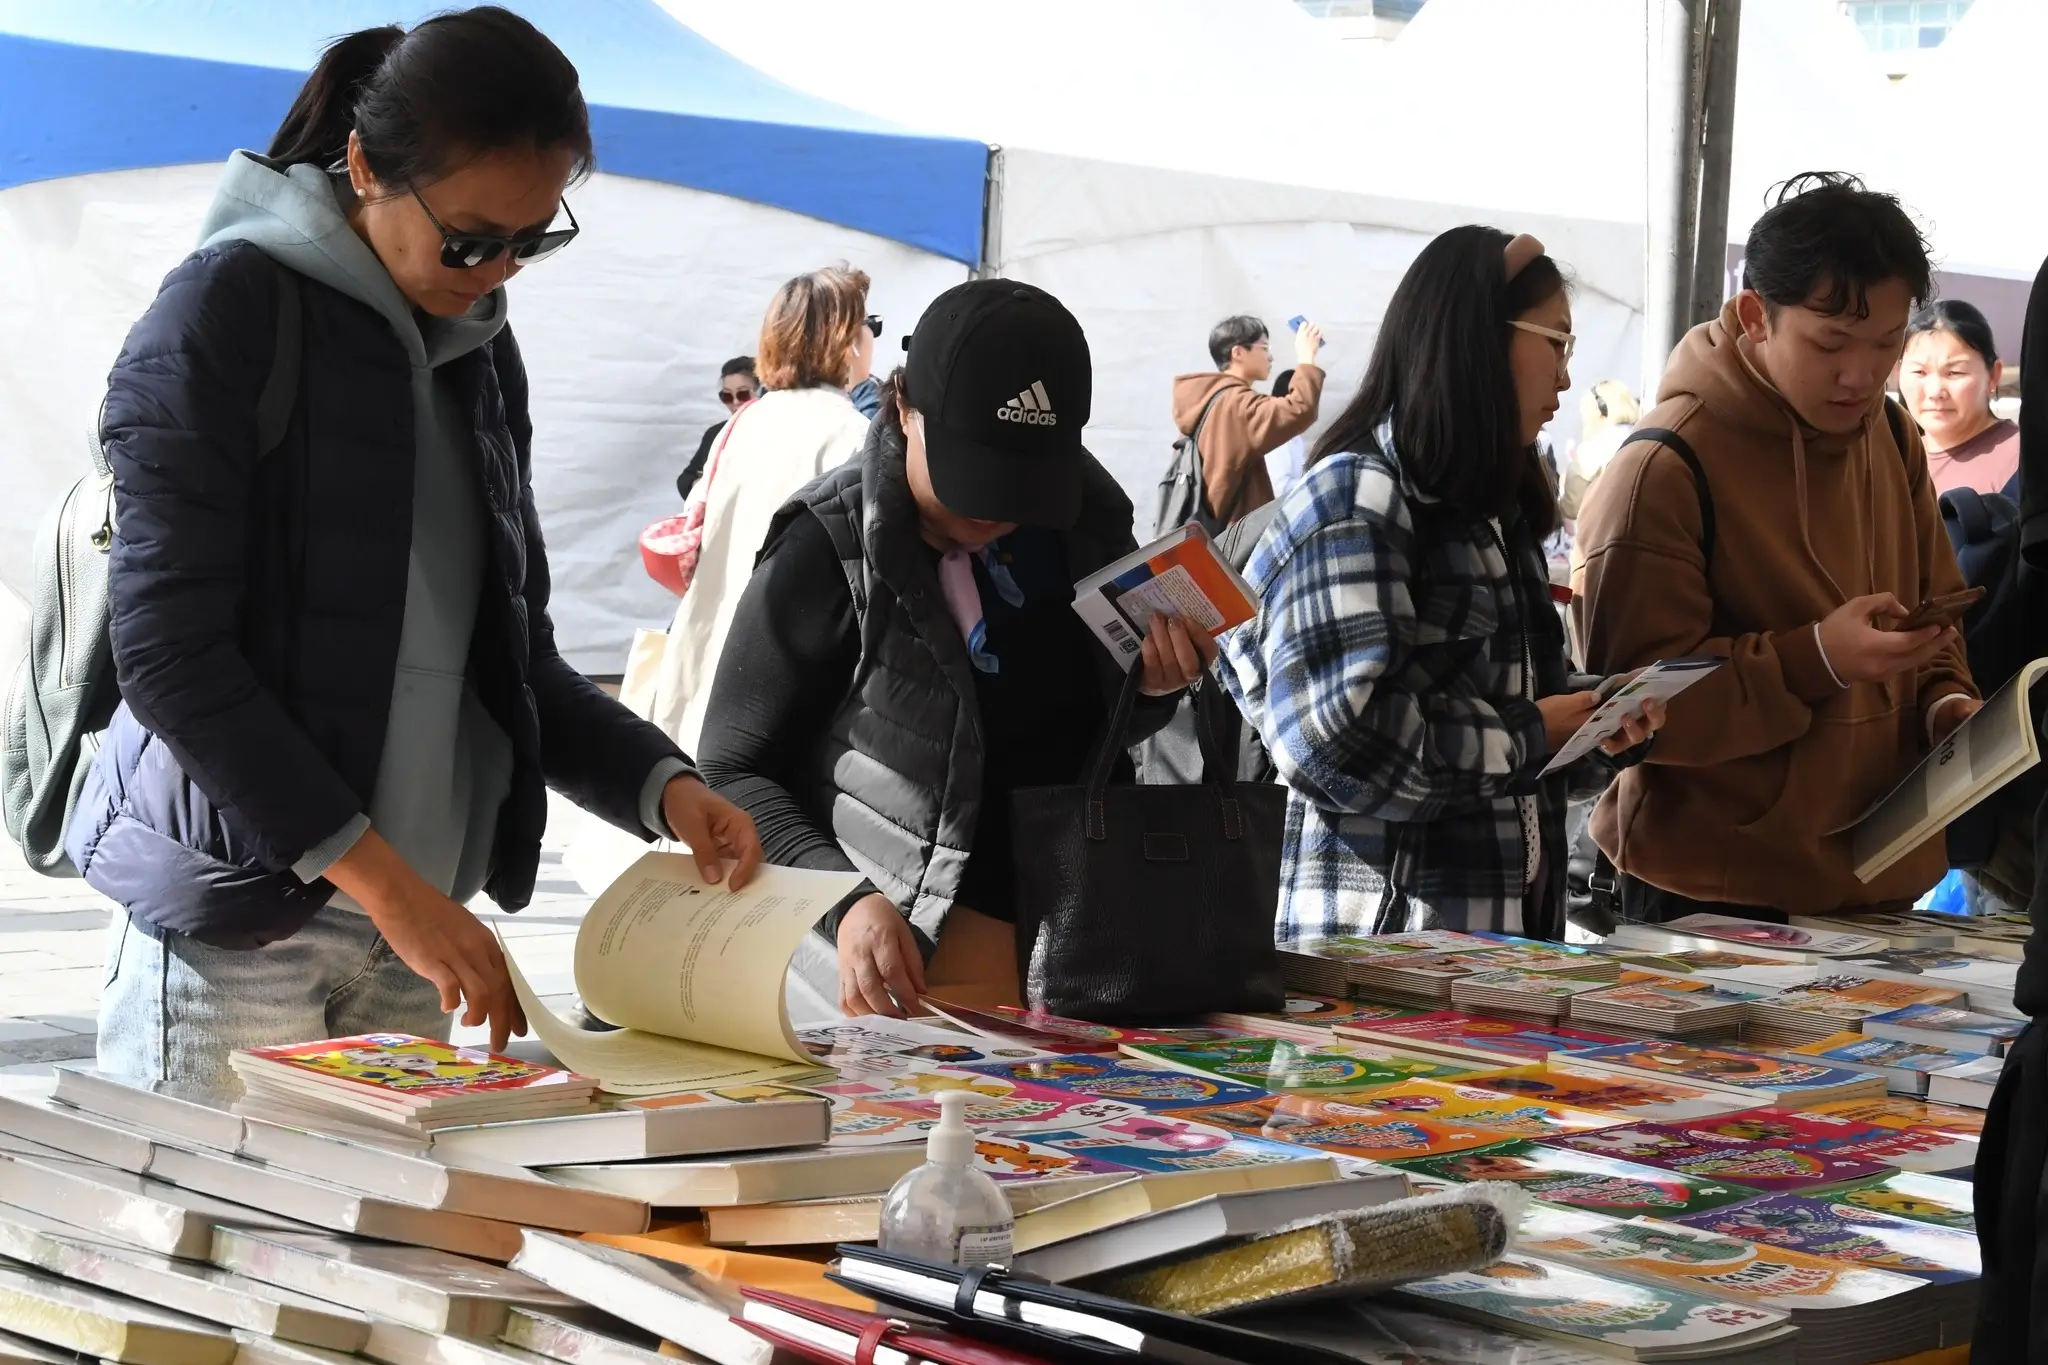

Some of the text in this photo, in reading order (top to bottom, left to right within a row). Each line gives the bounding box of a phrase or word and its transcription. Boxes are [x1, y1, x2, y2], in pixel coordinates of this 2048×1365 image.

[997, 407, 1057, 426] adidas
[1079, 1105, 1130, 1118] 5-6
[1688, 1261, 1788, 1284] ХИЧЭЭЛ
[1720, 1268, 1828, 1292] ЭЭЖИЙН
[1708, 1309, 1769, 1326] 3-4
